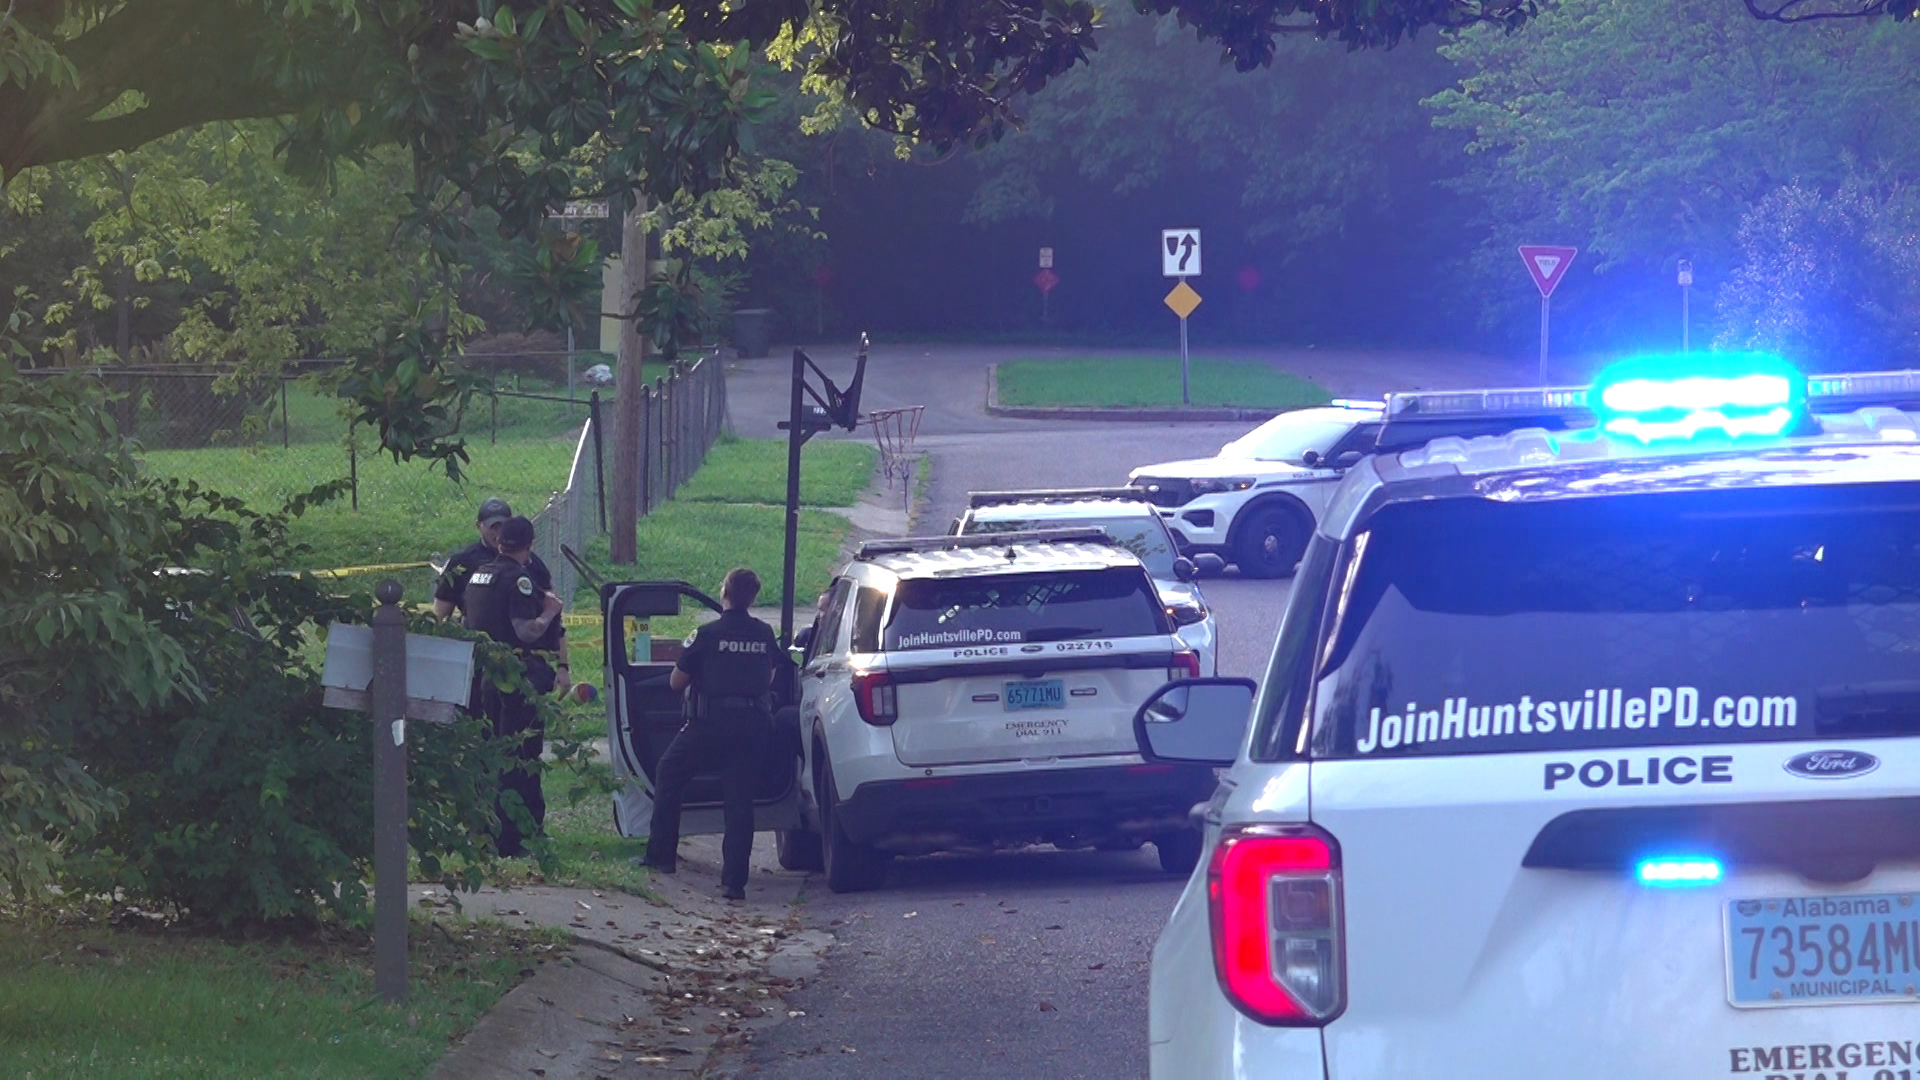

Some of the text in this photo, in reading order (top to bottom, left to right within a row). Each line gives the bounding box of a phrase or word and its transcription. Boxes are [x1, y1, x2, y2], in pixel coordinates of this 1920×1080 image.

[718, 639, 768, 654] POLICE
[898, 629, 1021, 649] JoinHuntsvillePD.com
[953, 647, 1008, 658] POLICE
[1007, 687, 1061, 704] 65771MU
[1005, 719, 1069, 730] EMERGENCY
[1357, 686, 1797, 754] JoinHuntsvillePD.com
[1015, 729, 1040, 738] DIAL
[1805, 753, 1857, 771] Ford
[1544, 756, 1733, 789] POLICE
[1782, 897, 1891, 917] Alabama
[1790, 979, 1897, 996] MUNICIPAL
[1729, 1041, 1920, 1073] EMERGEN
